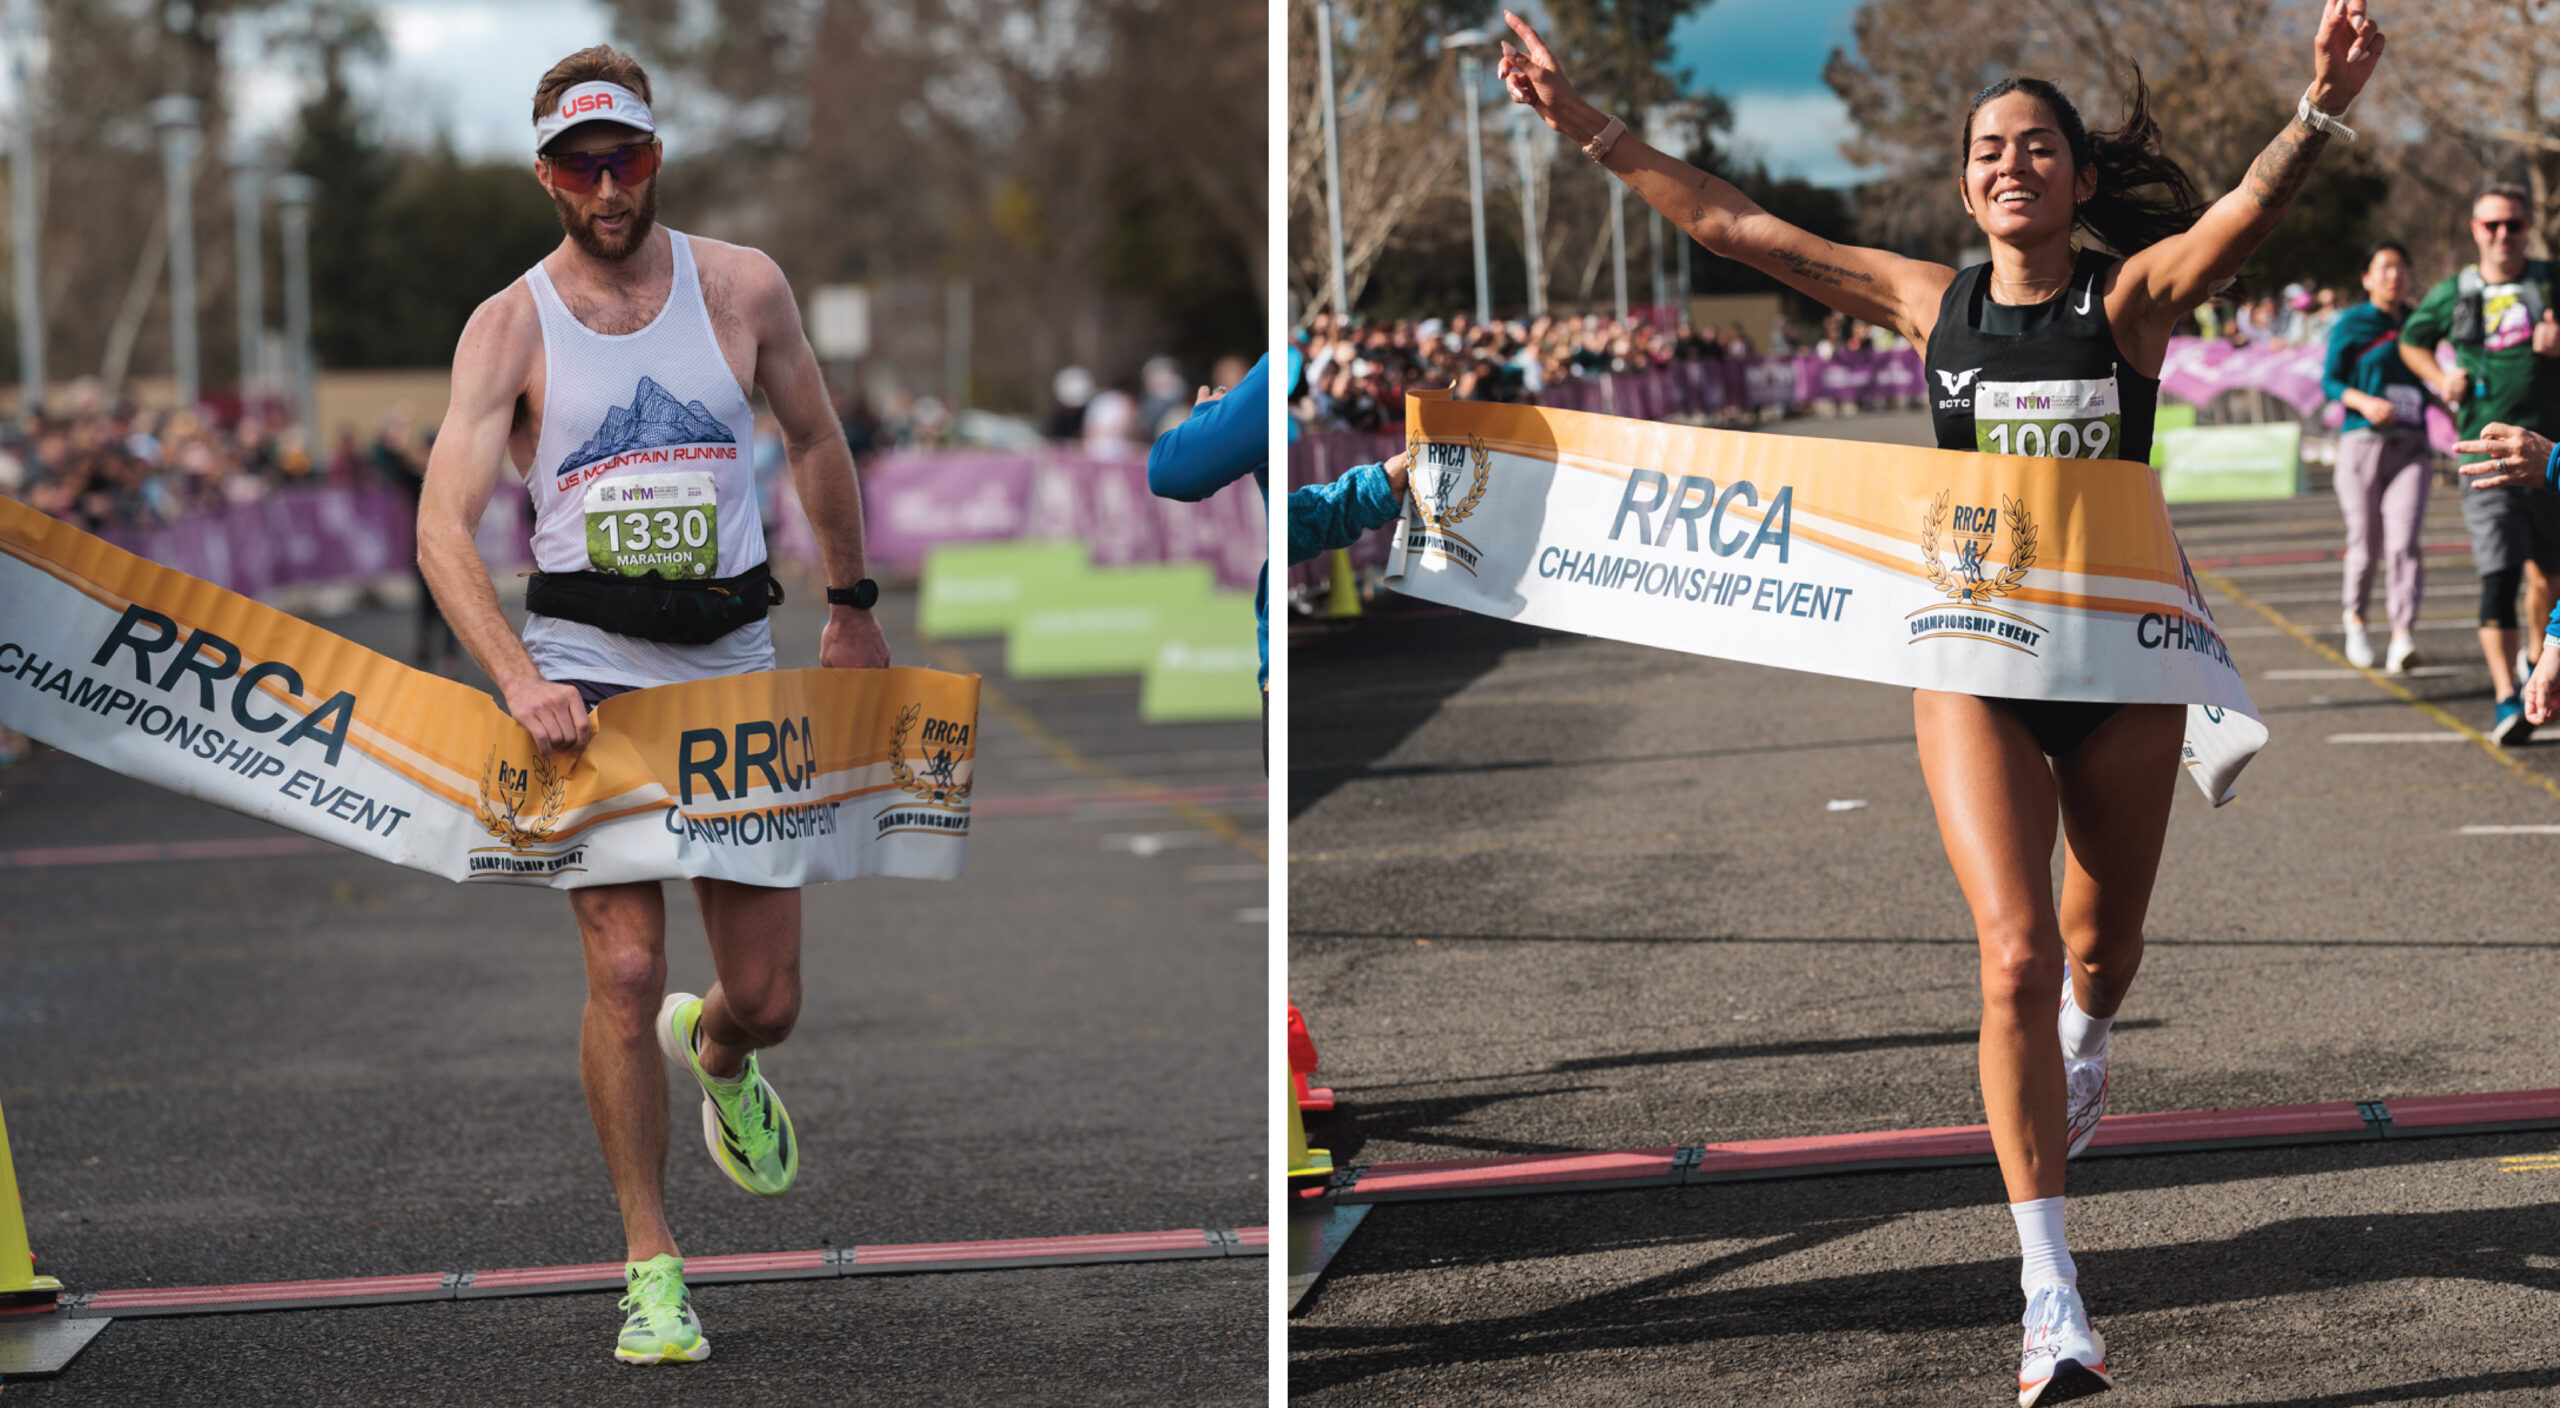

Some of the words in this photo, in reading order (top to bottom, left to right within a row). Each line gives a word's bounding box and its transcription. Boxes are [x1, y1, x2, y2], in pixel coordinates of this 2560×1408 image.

[562, 93, 613, 119] USA
[1428, 442, 1466, 468] RRCA
[1988, 420, 2111, 460] 1009
[557, 472, 580, 492] US
[584, 449, 669, 483] MOUNTAIN
[673, 447, 737, 461] RUNNING
[598, 509, 709, 553] 1330
[1607, 468, 1794, 564] RRCA
[1953, 505, 1997, 534] RRCA
[616, 551, 693, 566] MARATHON
[1538, 546, 1752, 607] CHAMPIONSHIP
[1752, 577, 1854, 623] EVENT
[1911, 614, 1996, 635] CHAMPIONSHIP
[1997, 622, 2041, 647] EVENT
[92, 603, 357, 767] RRCA
[0, 642, 285, 780] CHAMPIONSHIP
[279, 768, 411, 838] EVENT
[921, 718, 970, 746] RRCA
[679, 716, 816, 805] RRCA
[469, 857, 545, 872] CHAMPIONSHIP
[547, 851, 584, 871] EVENT
